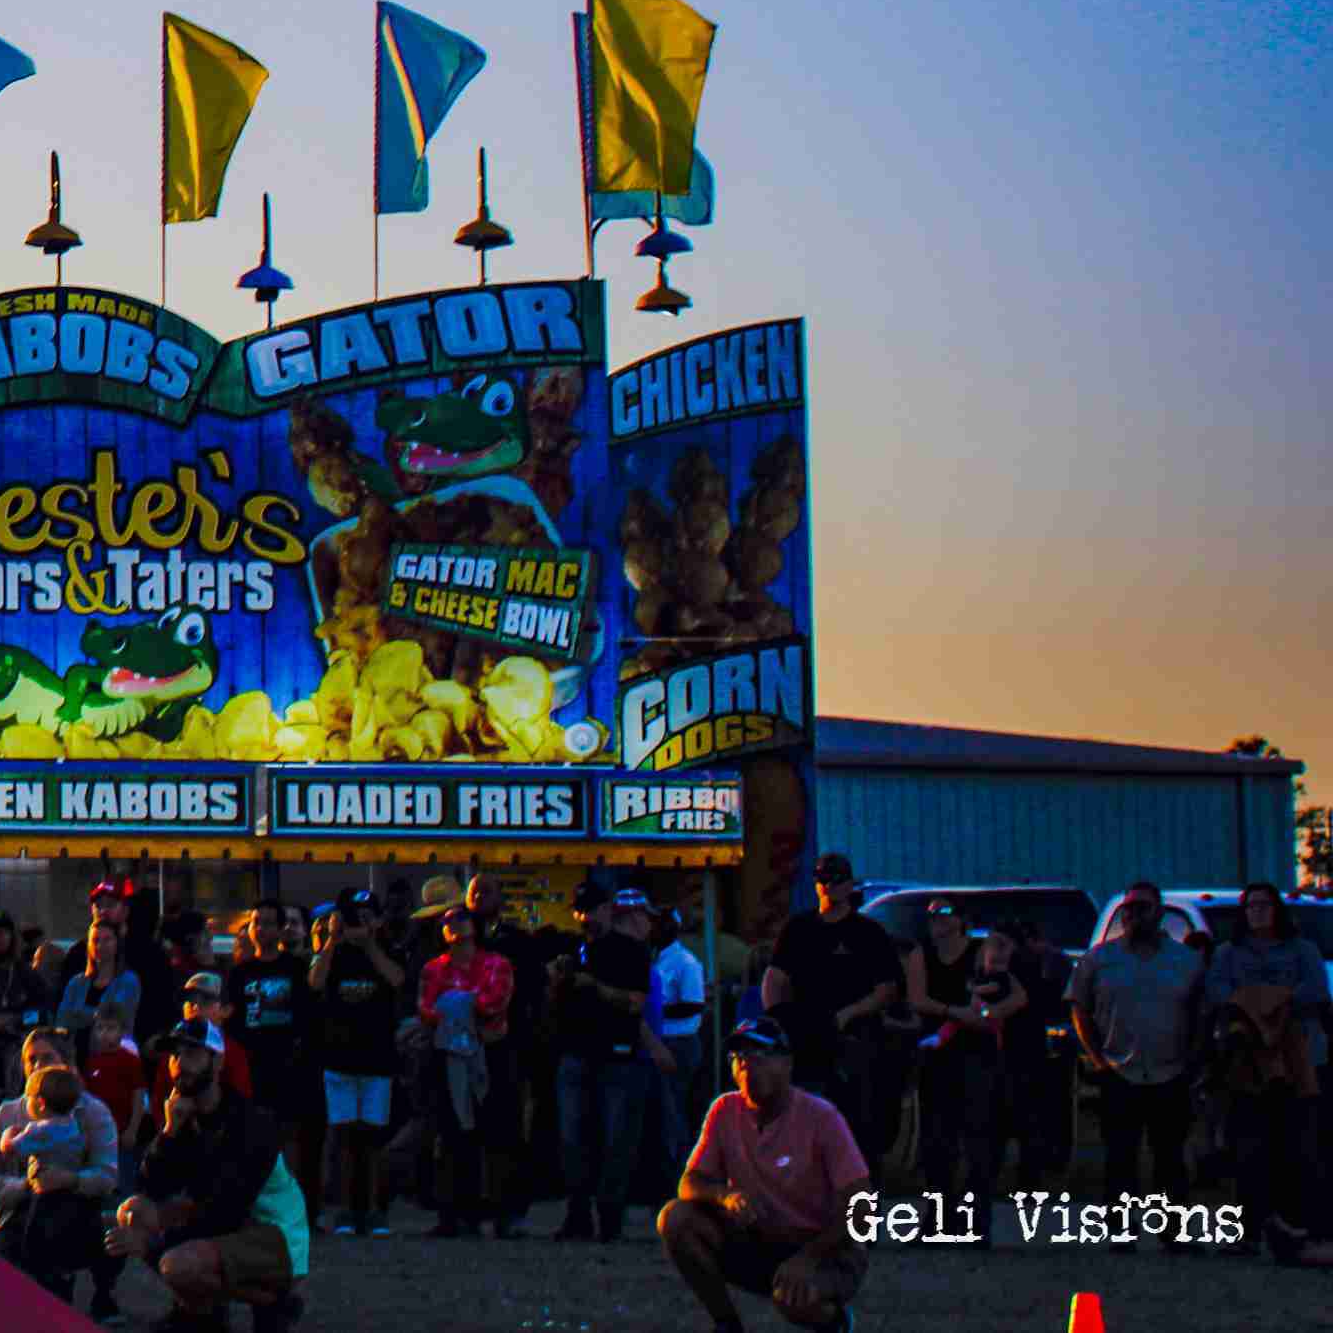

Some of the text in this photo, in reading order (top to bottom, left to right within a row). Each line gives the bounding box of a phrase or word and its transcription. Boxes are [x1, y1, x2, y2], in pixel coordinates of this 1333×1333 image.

[67, 293, 155, 326] MADE
[245, 285, 583, 398] GATOR
[612, 323, 799, 437] CHICKEN
[64, 538, 130, 616] &
[108, 548, 275, 612] Taters
[396, 553, 579, 599] GATOR MAC
[389, 581, 571, 648] & CHEESE BOWL
[622, 645, 804, 772] CORN
[654, 714, 775, 772] DOGS
[60, 781, 238, 821] KABOBS
[286, 782, 573, 826] LOADED FRIES
[661, 810, 726, 830] FRIES
